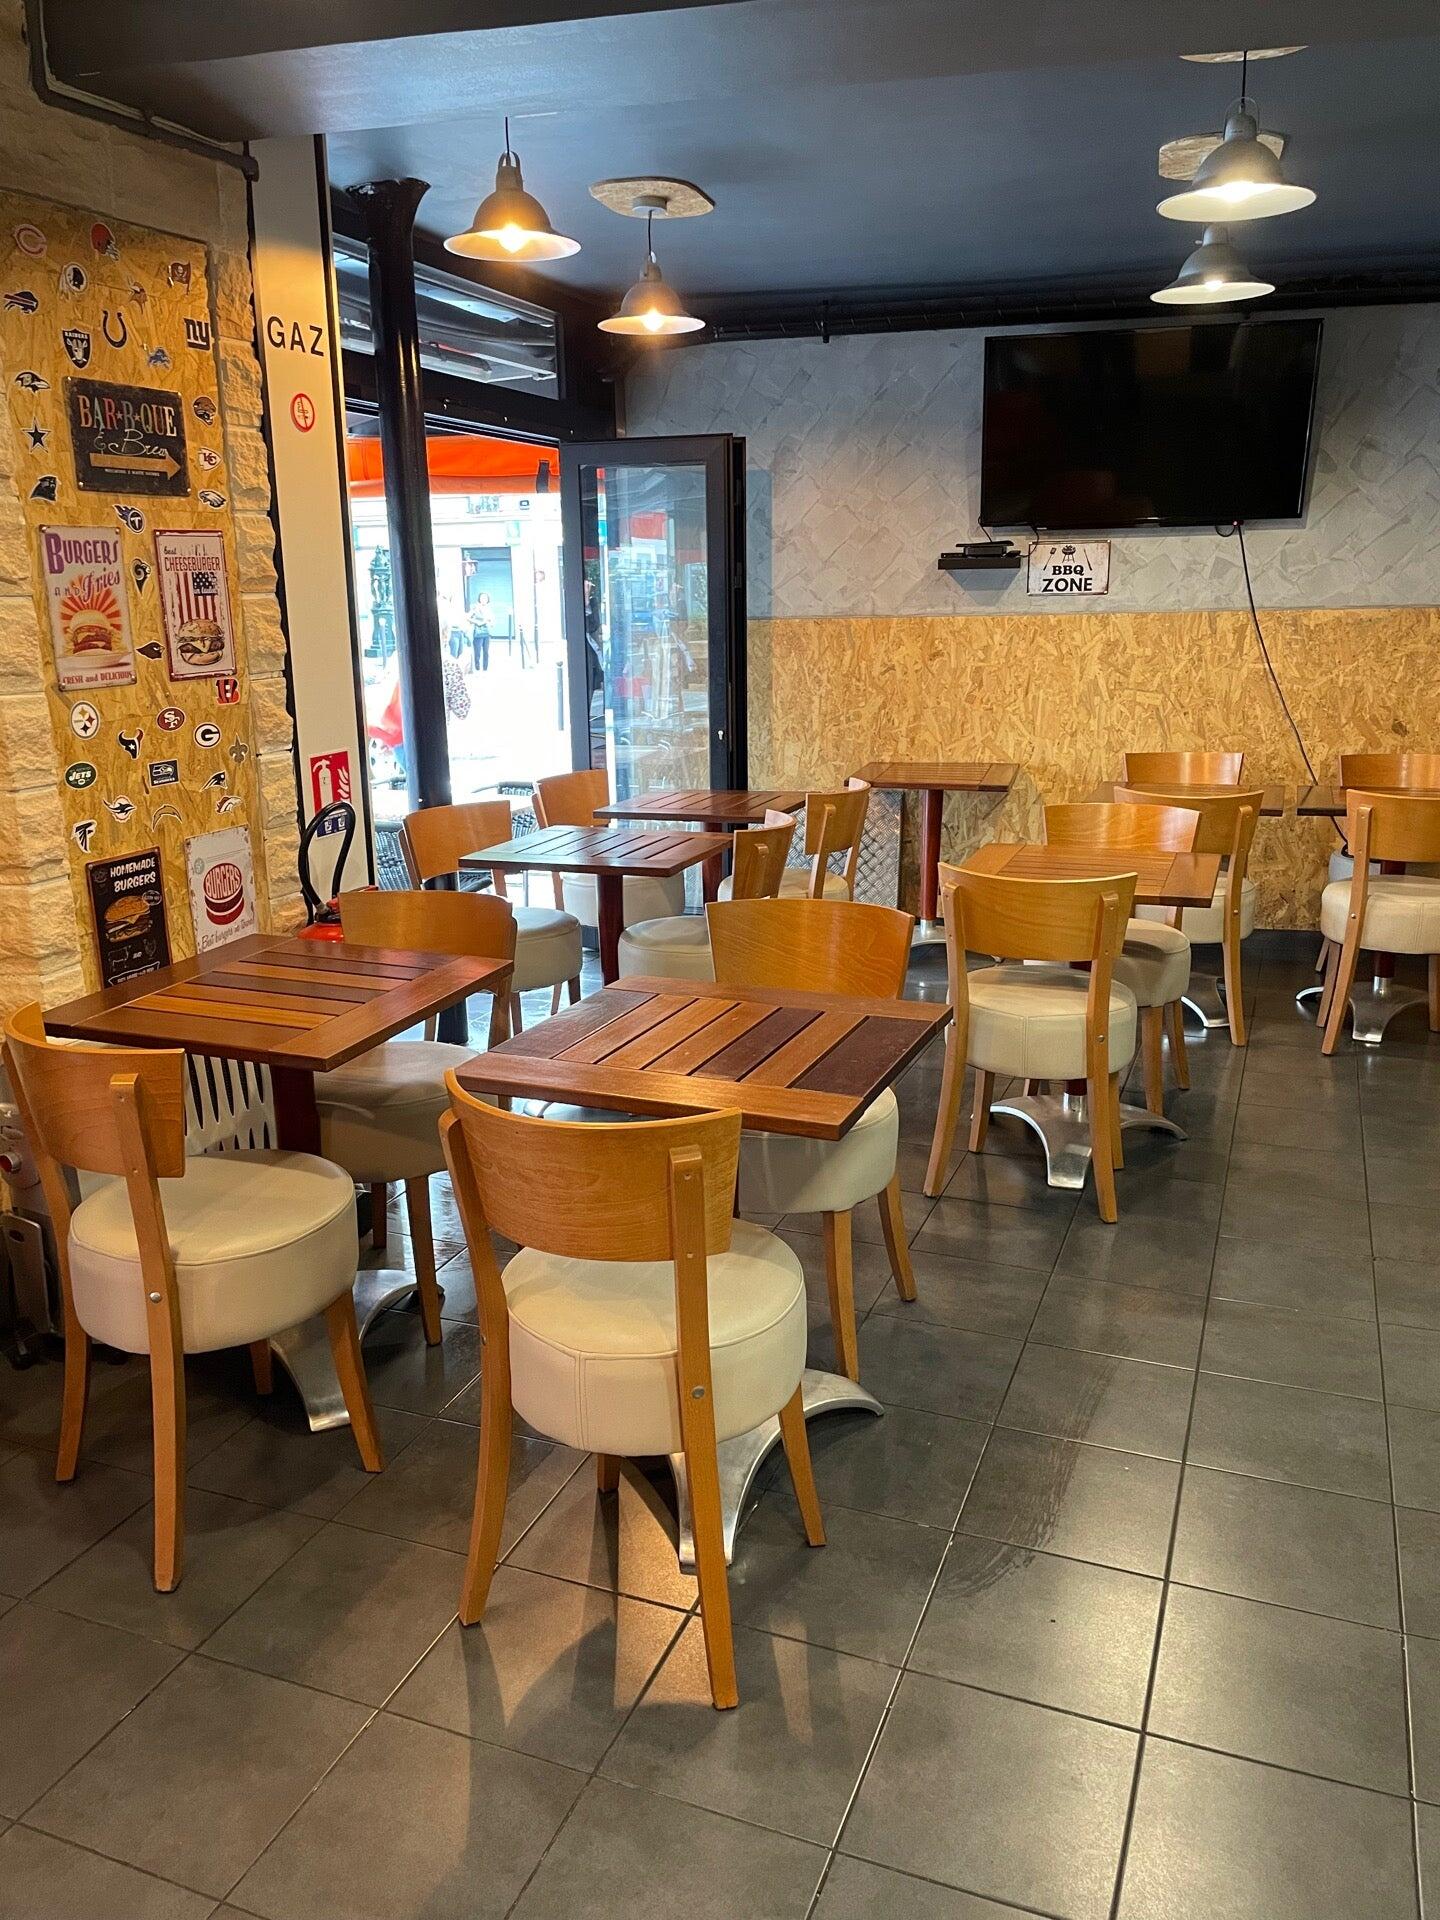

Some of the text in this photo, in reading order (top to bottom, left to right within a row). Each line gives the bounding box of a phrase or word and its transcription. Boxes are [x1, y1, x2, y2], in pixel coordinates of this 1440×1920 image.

[267, 316, 324, 357] GAZ
[45, 533, 119, 574] BURGERS
[164, 556, 220, 572] CHEESEBURGER
[1051, 564, 1085, 576] BBQ
[82, 567, 120, 603] Fries
[1042, 577, 1093, 593] ZONE
[63, 671, 132, 684] FRESH and DELICIOUS
[68, 770, 92, 782] JETS
[110, 857, 156, 878] HOMEMADE
[114, 871, 156, 892] BURGERS
[205, 864, 241, 898] BURGERS
